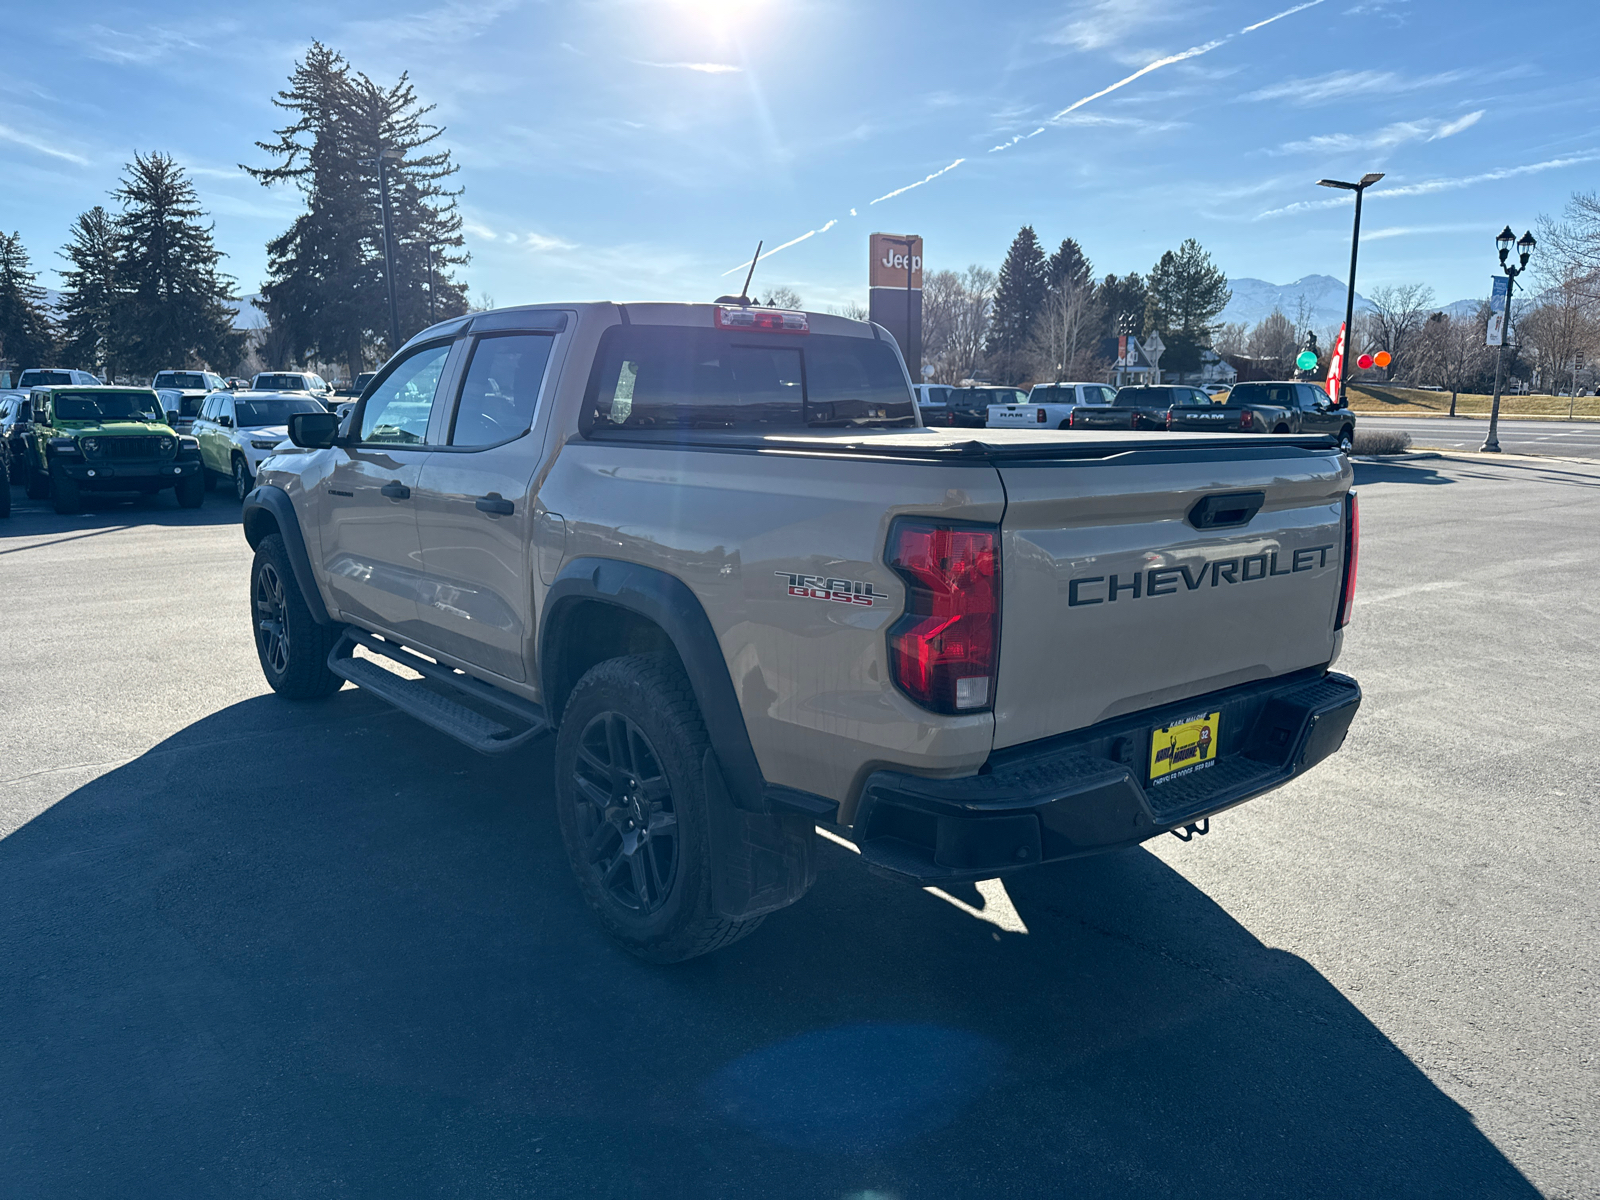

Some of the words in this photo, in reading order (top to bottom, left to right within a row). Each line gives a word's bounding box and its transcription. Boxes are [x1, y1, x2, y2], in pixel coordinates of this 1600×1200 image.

[882, 249, 921, 274] Jeep
[774, 570, 888, 599] TRAIL
[1068, 544, 1334, 607] CHEVROLET
[788, 585, 874, 607] BOSS
[1201, 730, 1208, 739] 32
